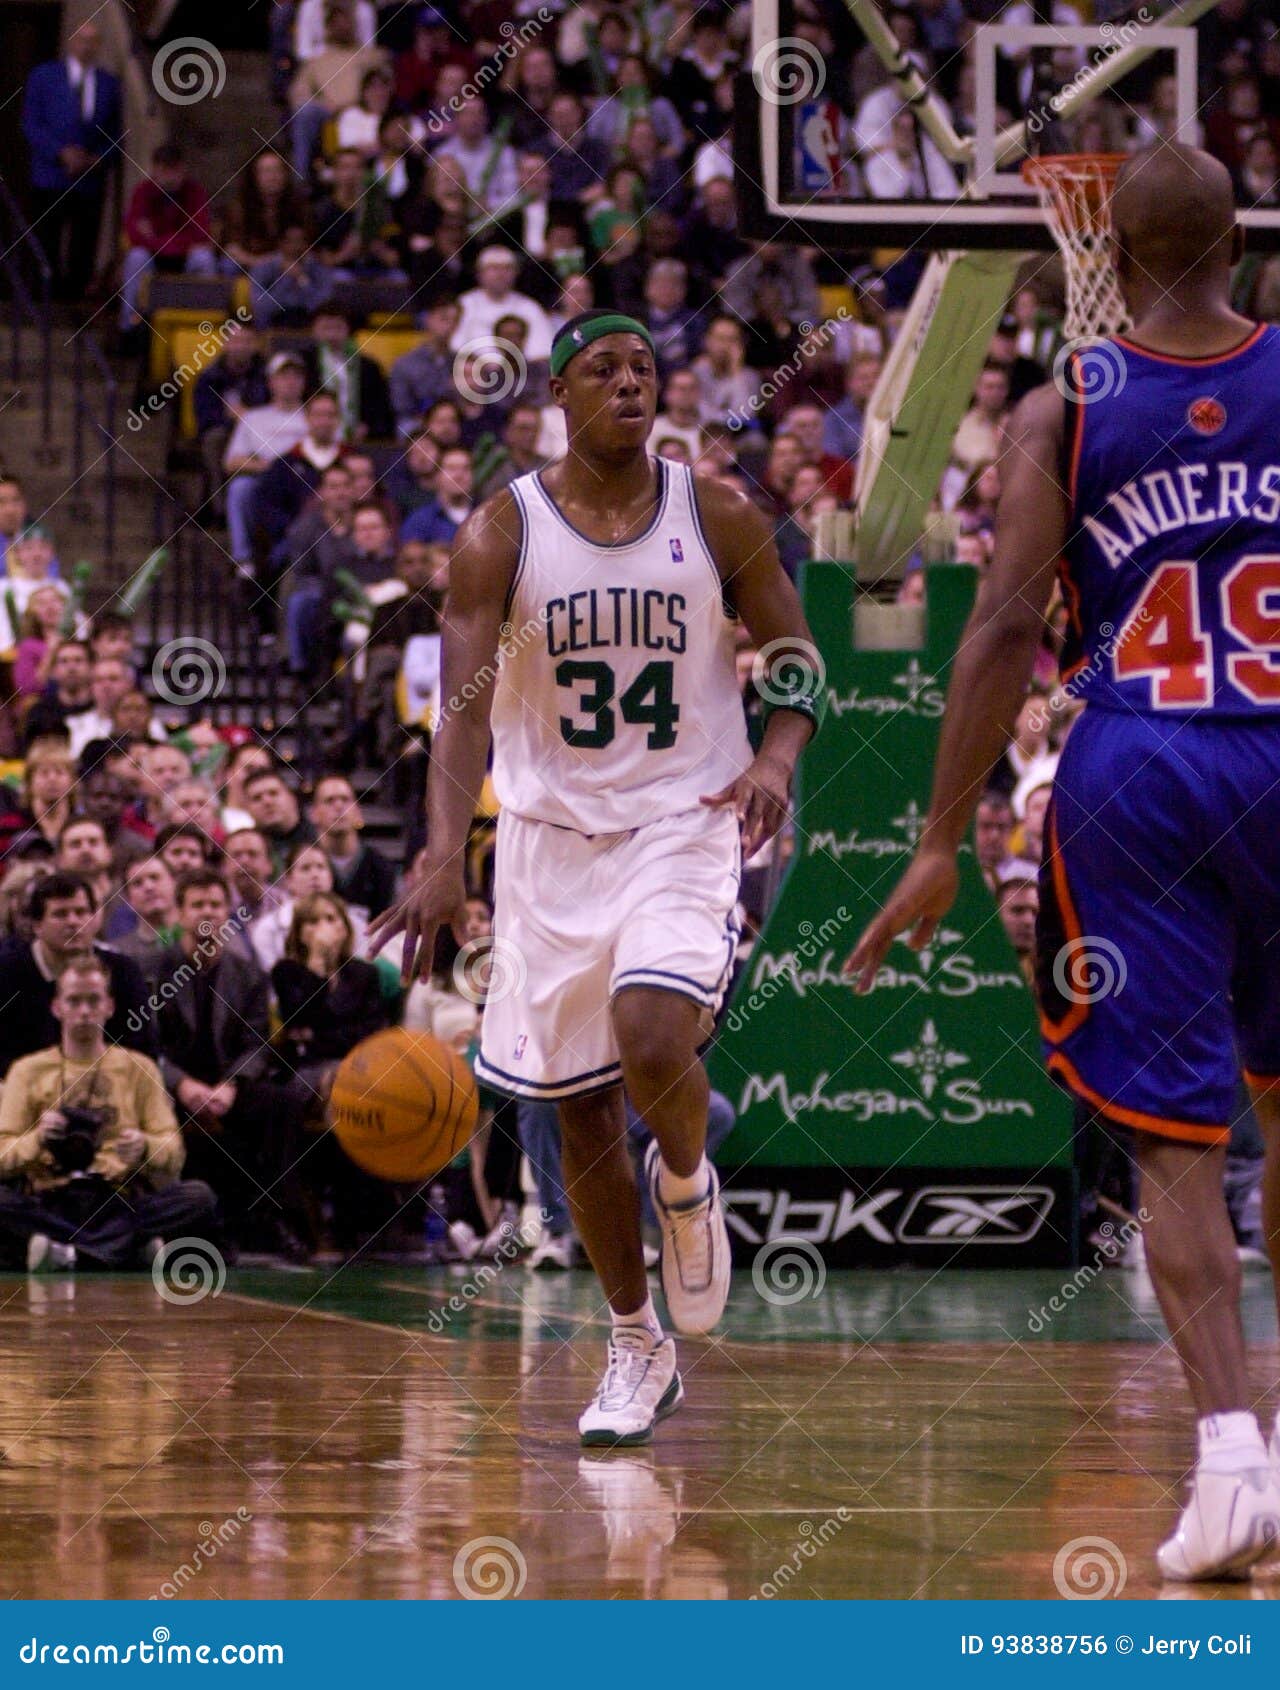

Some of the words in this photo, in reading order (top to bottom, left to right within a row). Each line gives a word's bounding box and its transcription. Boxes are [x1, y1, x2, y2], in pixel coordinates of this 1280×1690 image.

[1082, 462, 1280, 569] ANDERS
[546, 587, 687, 657] CELTICS
[555, 659, 681, 750] 34
[938, 954, 1024, 997] Sun
[739, 1072, 935, 1124] Mohegan
[941, 1078, 1035, 1125] Sun
